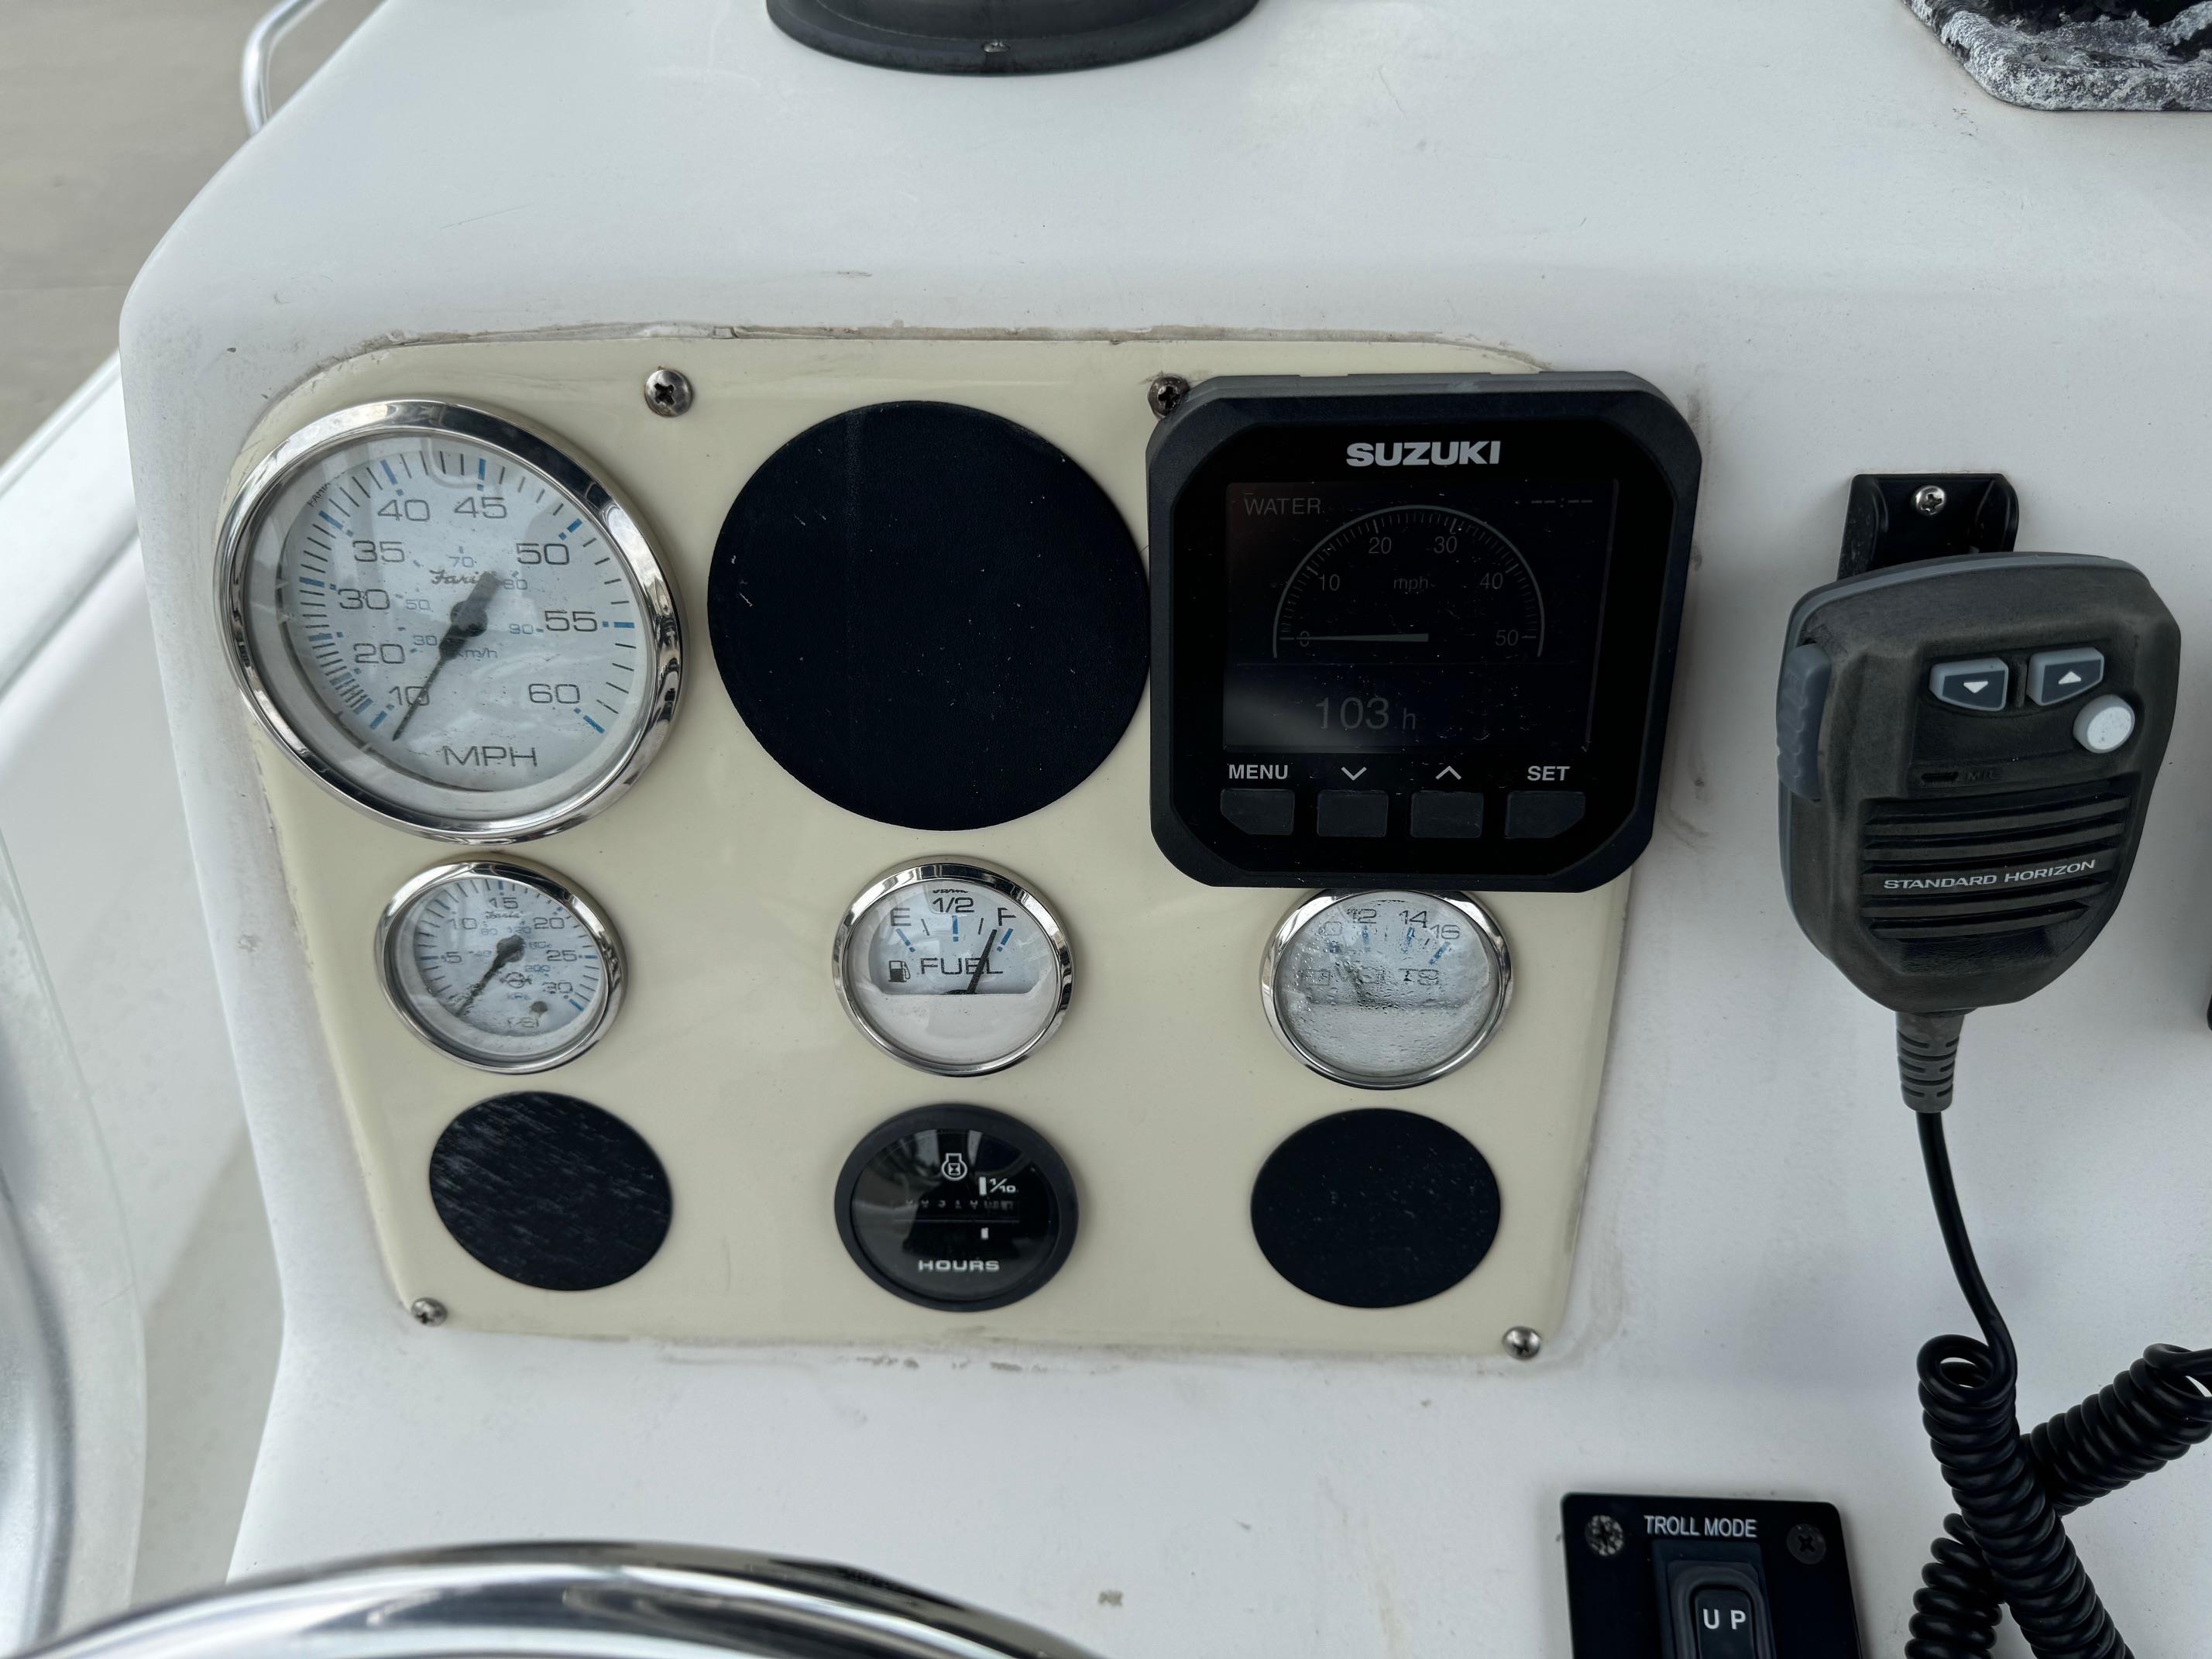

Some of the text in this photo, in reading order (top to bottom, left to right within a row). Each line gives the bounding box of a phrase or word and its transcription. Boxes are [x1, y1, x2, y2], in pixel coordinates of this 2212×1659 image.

[1346, 440, 1501, 467] SUZUKI
[378, 499, 431, 522] 40
[454, 497, 507, 520] 45
[1245, 497, 1322, 516] WATER
[352, 541, 405, 563] 35
[517, 543, 570, 565] 50
[1368, 536, 1392, 554] 20
[1433, 536, 1458, 554] 30
[448, 557, 474, 568] 70
[429, 569, 480, 584] Fari
[503, 579, 527, 590] 80
[1319, 574, 1340, 592] 10
[1393, 576, 1429, 593] mph
[1480, 572, 1503, 591] 40
[338, 589, 390, 610] 30
[405, 599, 431, 610] 50
[509, 623, 534, 635] 90
[545, 611, 597, 632] 55
[413, 635, 438, 646] 30
[1495, 629, 1519, 647] 50
[353, 644, 405, 665] 20
[389, 685, 431, 706] 10
[528, 684, 581, 705] 60
[1315, 698, 1417, 731] 103 h
[443, 746, 537, 767] MPH
[1228, 764, 1289, 780] MENU
[1527, 765, 1570, 781] SET
[1883, 859, 2095, 890] STANDARD HORIZON
[489, 898, 519, 909] 15
[933, 897, 975, 913] 1/2
[447, 918, 478, 929] 10
[533, 917, 565, 930] 20
[891, 908, 912, 926] E
[998, 908, 1017, 926] F
[1399, 910, 1427, 929] 14
[1430, 924, 1462, 939] 16
[445, 952, 463, 963] 5
[547, 950, 578, 962] 25
[920, 957, 1004, 975] FUEL
[542, 982, 573, 994] 30
[989, 1177, 1016, 1193] 1/10
[918, 1259, 1000, 1273] HOURS
[1644, 1515, 1758, 1537] TROLL MODE
[1703, 1609, 1747, 1630] UP
